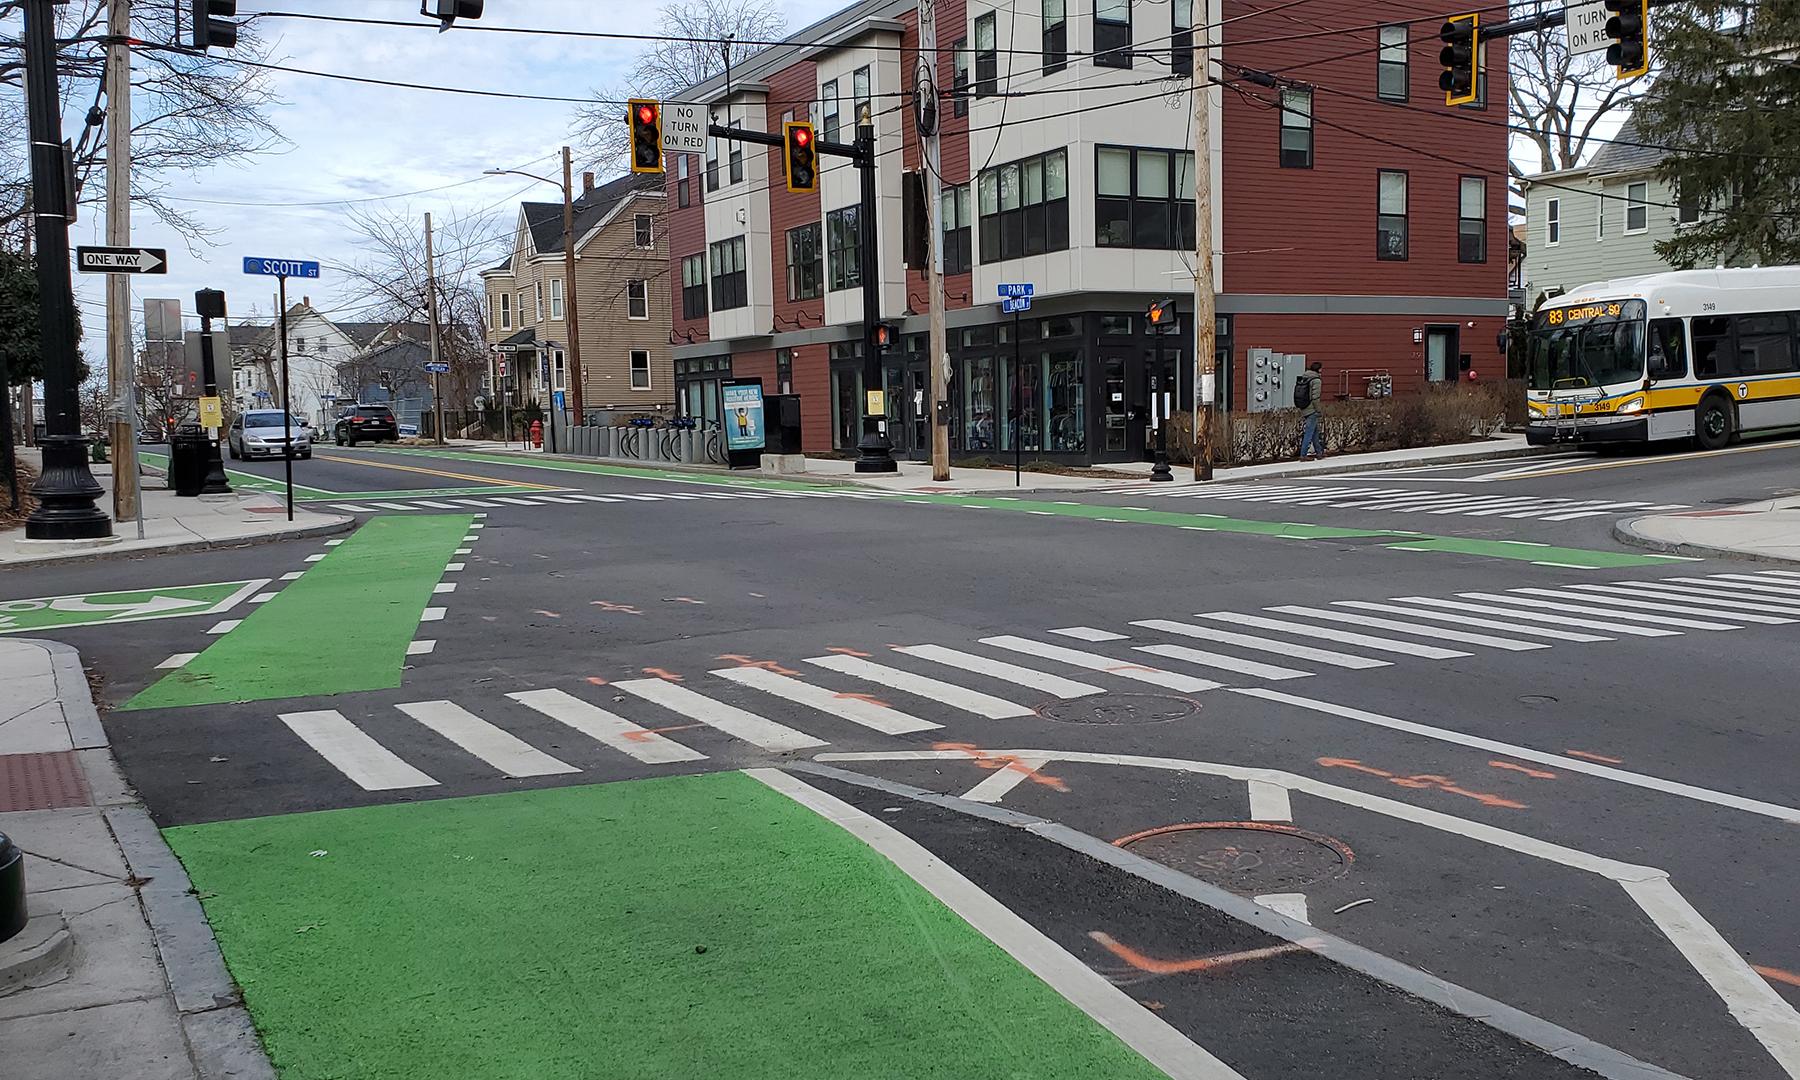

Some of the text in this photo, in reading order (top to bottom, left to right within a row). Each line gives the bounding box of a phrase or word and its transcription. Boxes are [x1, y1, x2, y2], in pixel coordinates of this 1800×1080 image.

[1577, 9, 1606, 26] TURN
[1572, 28, 1608, 47] ON RE
[677, 107, 694, 118] NO
[671, 121, 699, 133] TURN
[664, 135, 704, 147] ON RED
[86, 254, 141, 266] ONE WAY
[262, 259, 317, 277] SCOTT ST
[1007, 285, 1026, 296] PARK
[1702, 302, 1716, 312] 3149
[1549, 304, 1621, 324] 83 CENTRAL SQ
[1594, 402, 1611, 412] 3149
